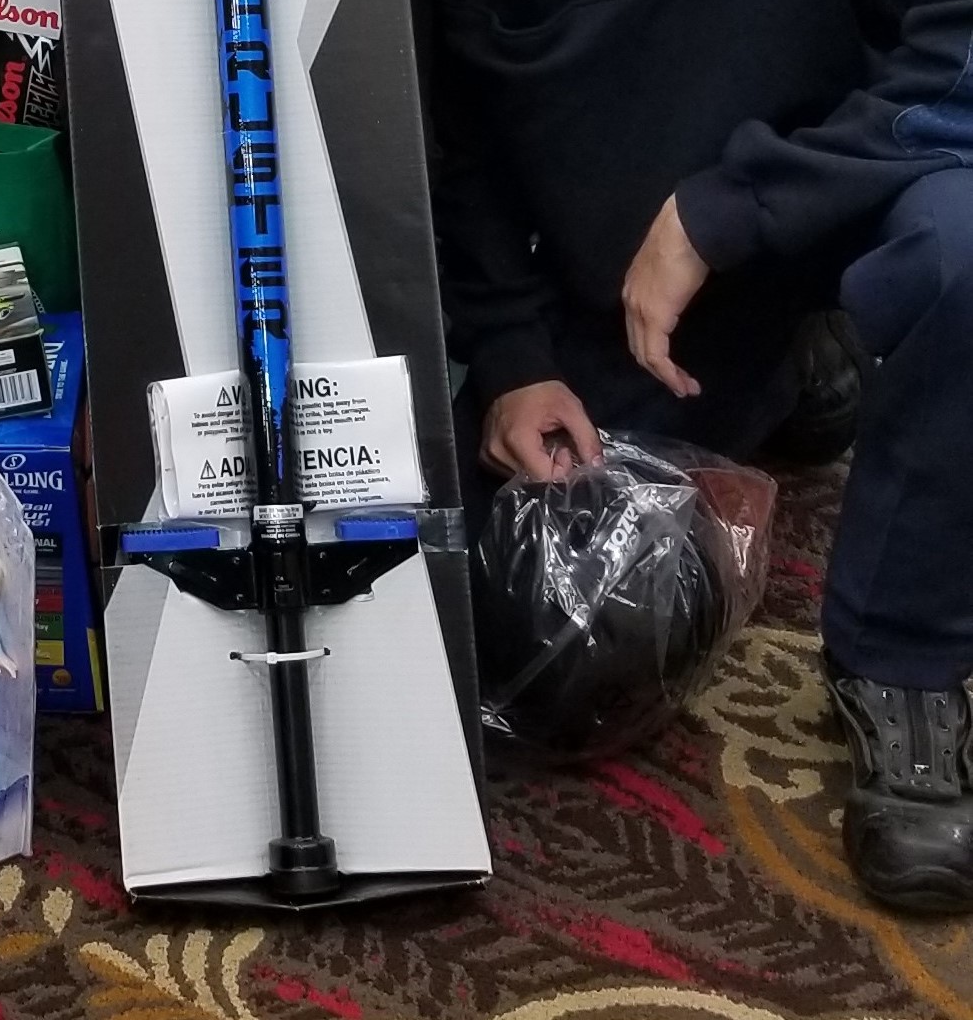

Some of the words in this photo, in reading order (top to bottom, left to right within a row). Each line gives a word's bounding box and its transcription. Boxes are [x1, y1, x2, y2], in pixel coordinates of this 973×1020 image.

[3, 470, 63, 491] LDING
[35, 538, 57, 547] NAL
[602, 503, 640, 562] azor
